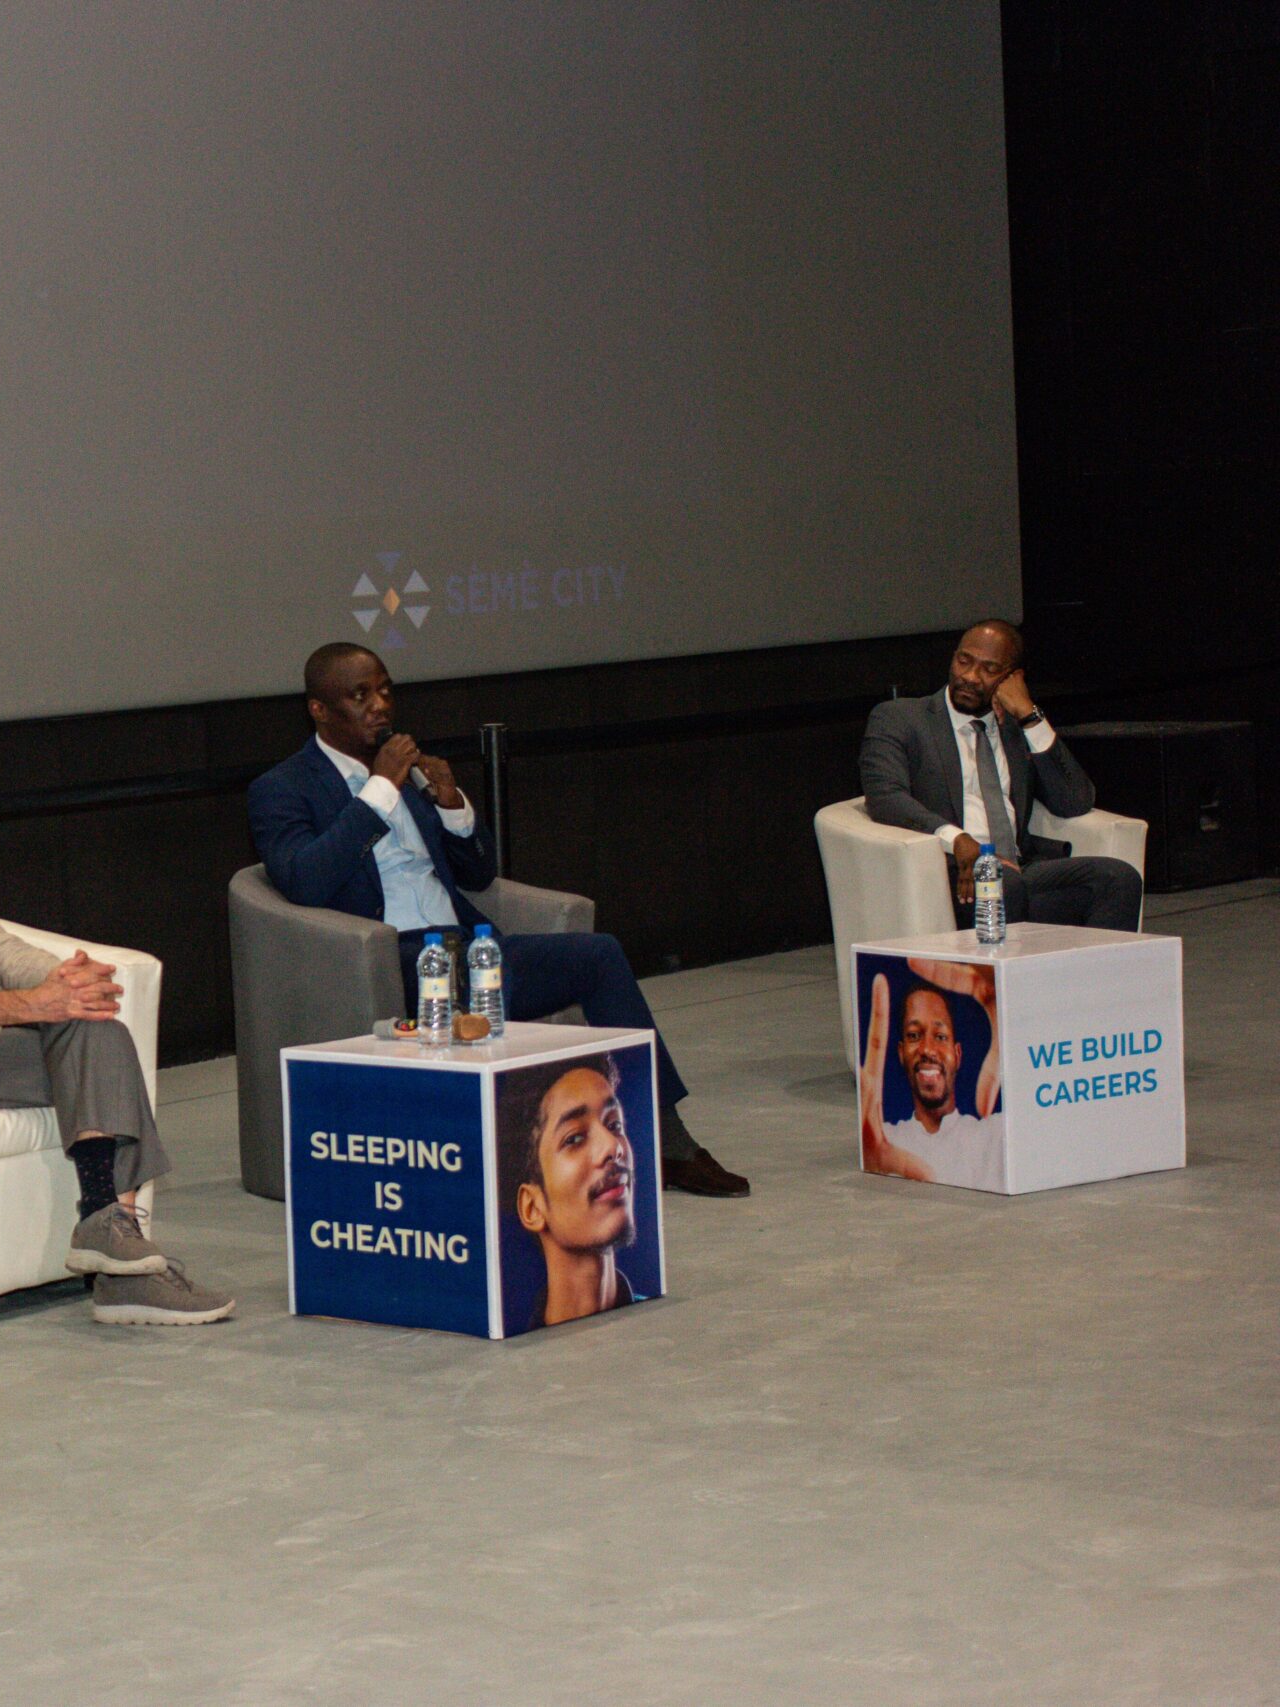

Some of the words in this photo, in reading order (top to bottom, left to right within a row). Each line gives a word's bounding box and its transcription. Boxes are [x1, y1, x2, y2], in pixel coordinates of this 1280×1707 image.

[551, 562, 627, 608] CITY
[1028, 1040, 1073, 1069] WE
[1082, 1029, 1162, 1062] BUILD
[1035, 1068, 1157, 1107] CAREERS
[310, 1131, 462, 1171] SLEEPING
[375, 1181, 403, 1211] IS
[310, 1220, 469, 1263] CHEATING
